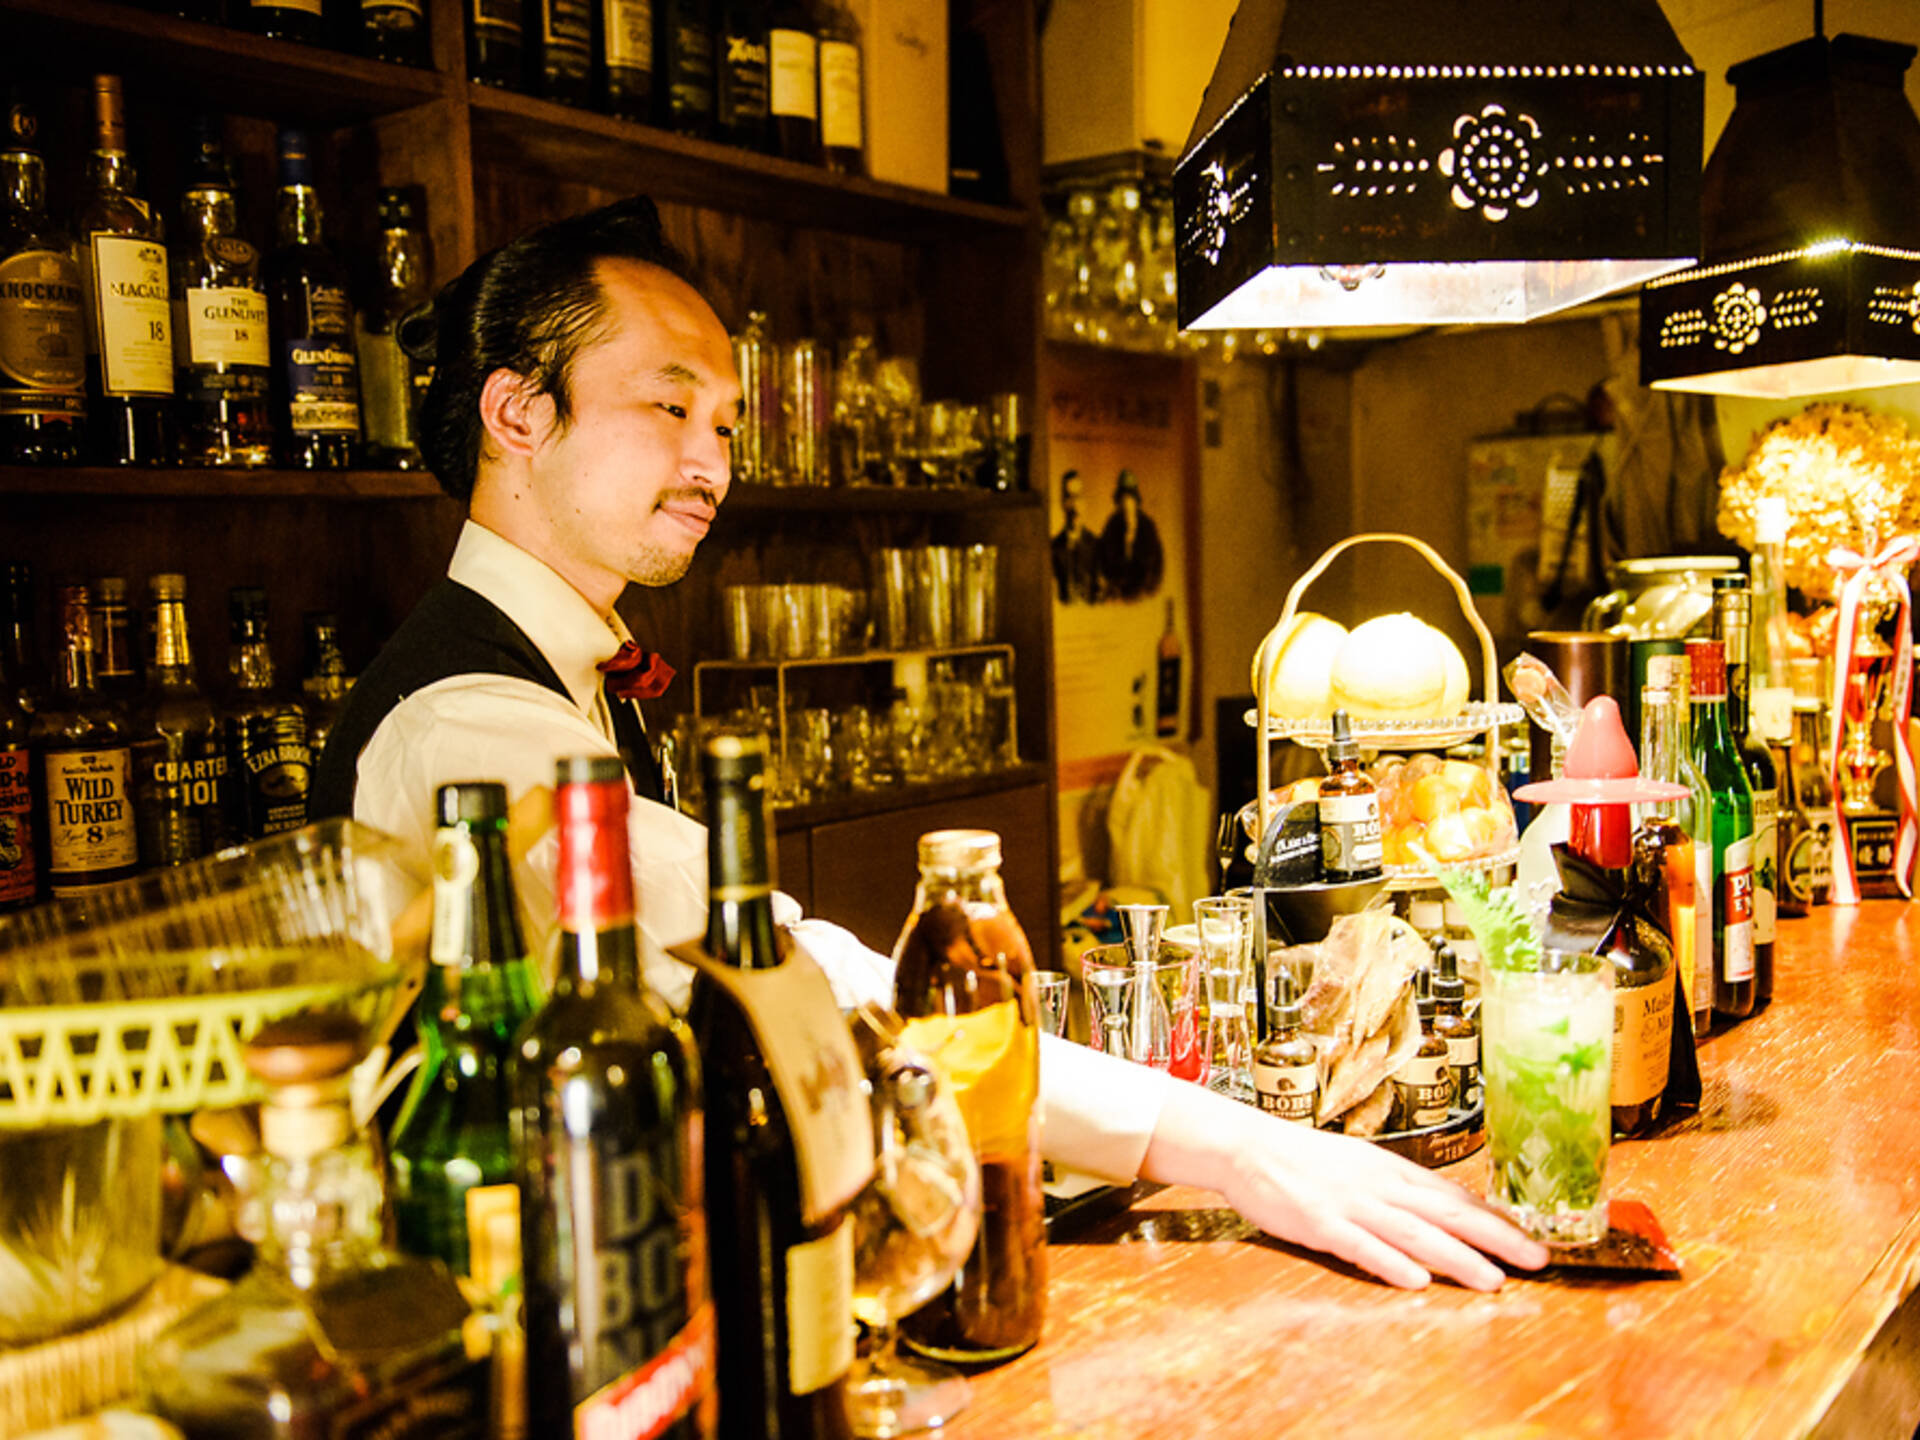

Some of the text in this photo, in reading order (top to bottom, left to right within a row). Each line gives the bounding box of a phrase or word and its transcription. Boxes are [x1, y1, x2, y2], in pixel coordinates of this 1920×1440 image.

[149, 320, 165, 342] 18
[65, 777, 114, 800] WILD
[183, 779, 218, 807] 101
[55, 799, 125, 826] TURKEY
[86, 825, 104, 844] 8
